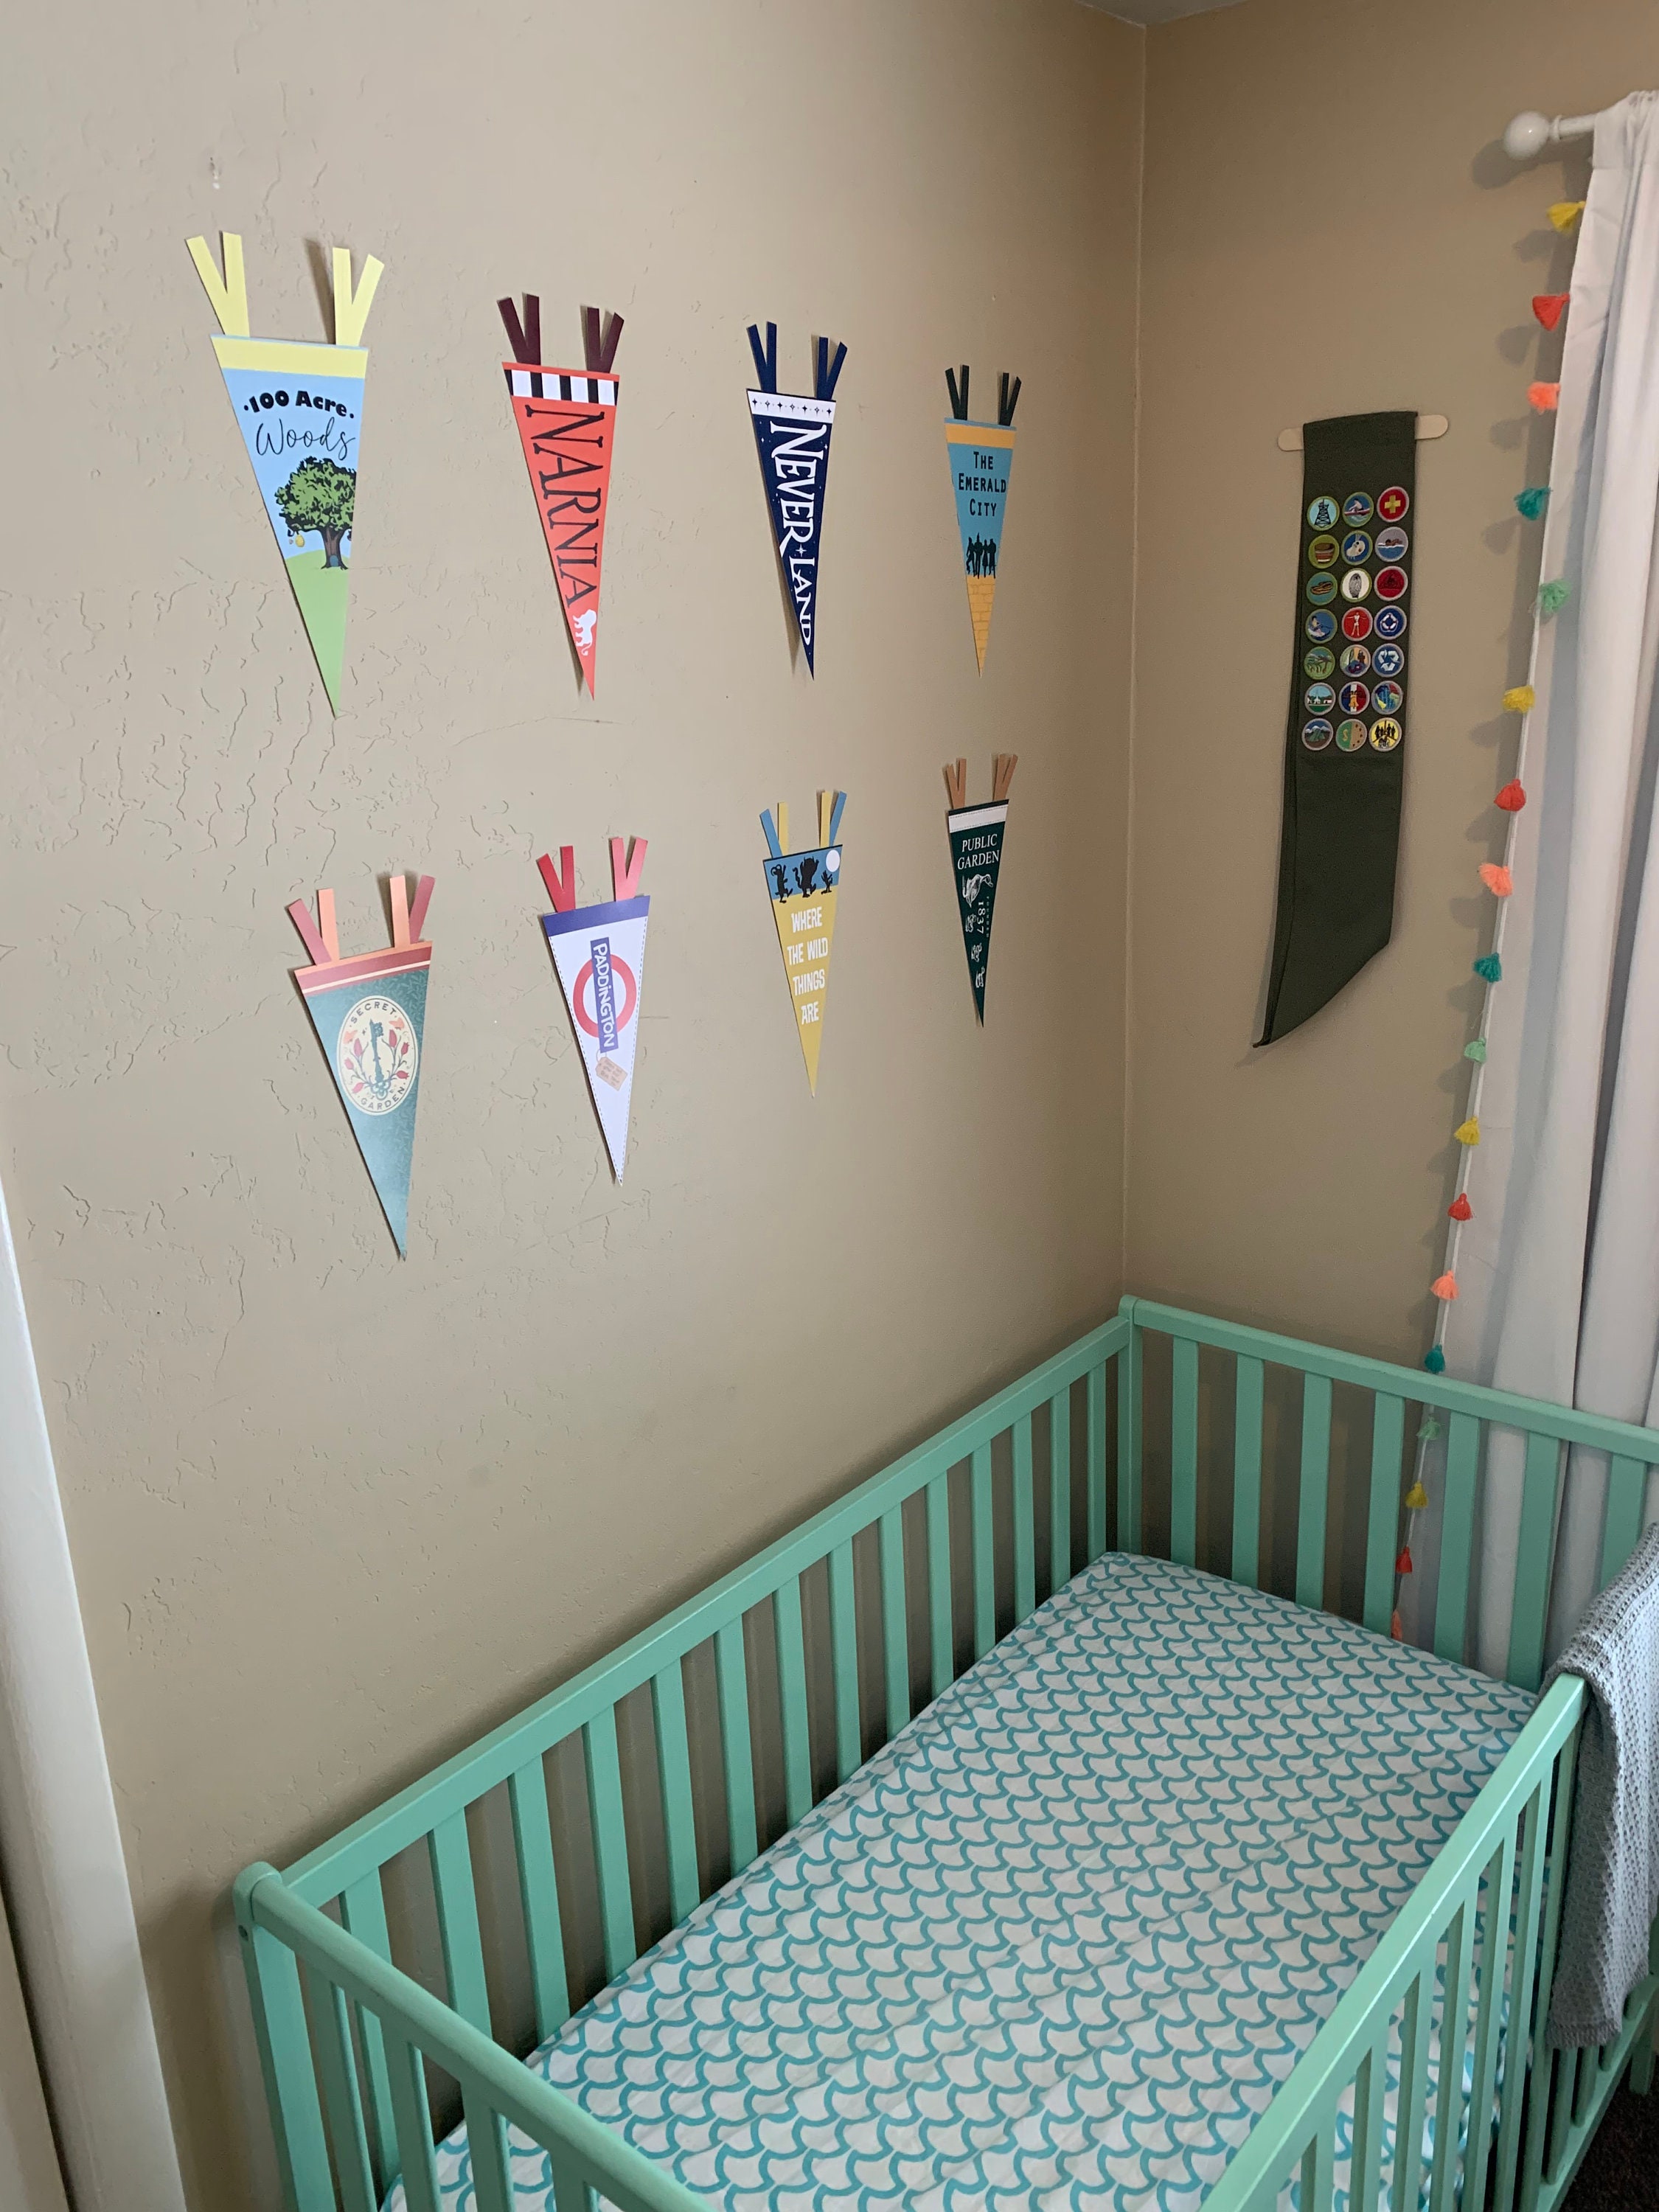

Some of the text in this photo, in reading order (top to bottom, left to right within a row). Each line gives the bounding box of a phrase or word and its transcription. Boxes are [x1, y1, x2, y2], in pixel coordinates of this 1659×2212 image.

[249, 390, 347, 417] 100 Acre
[256, 417, 355, 460] Woods
[959, 473, 1006, 493] EMERALD
[525, 404, 605, 608] NARNIA
[970, 498, 997, 516] CITY
[961, 833, 998, 852] PUBLIC
[957, 849, 999, 870] GARDEN
[790, 906, 822, 933] WHERE
[976, 901, 986, 933] 1837
[787, 937, 828, 965] THE WILD
[793, 969, 825, 996] THINGS
[350, 1001, 397, 1023] SECRET
[801, 1001, 819, 1025] ARE
[361, 1086, 406, 1110] GARDEN
